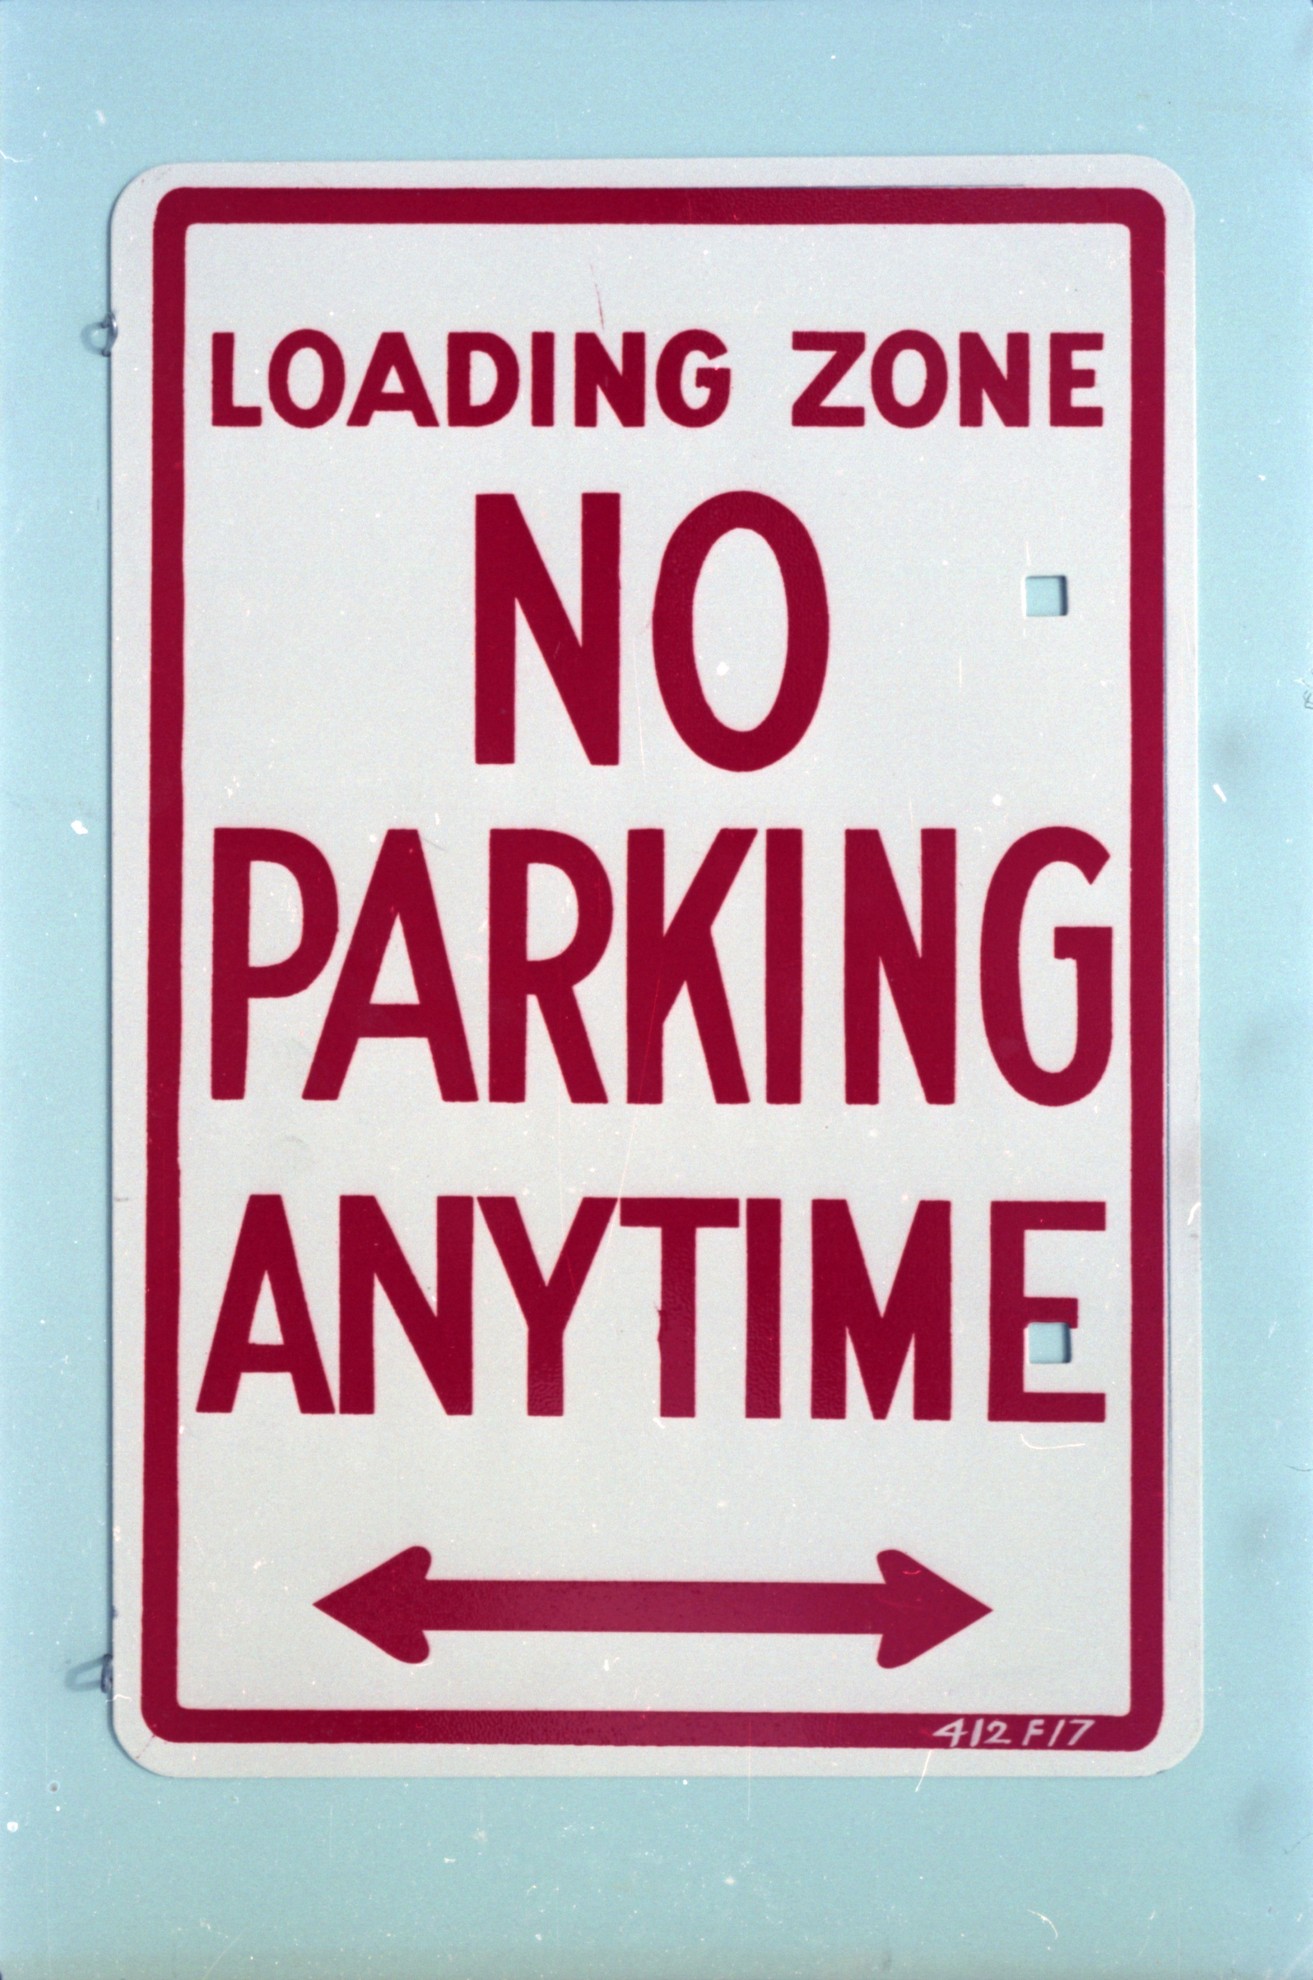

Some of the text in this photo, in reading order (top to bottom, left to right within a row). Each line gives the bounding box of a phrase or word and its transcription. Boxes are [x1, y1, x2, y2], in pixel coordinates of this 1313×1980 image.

[211, 328, 1104, 429] LOADING ZONE
[474, 490, 830, 773] NO
[210, 825, 1114, 1107] PARKING
[195, 1193, 1107, 1423] ANYTIME
[932, 1718, 1012, 1747] 412
